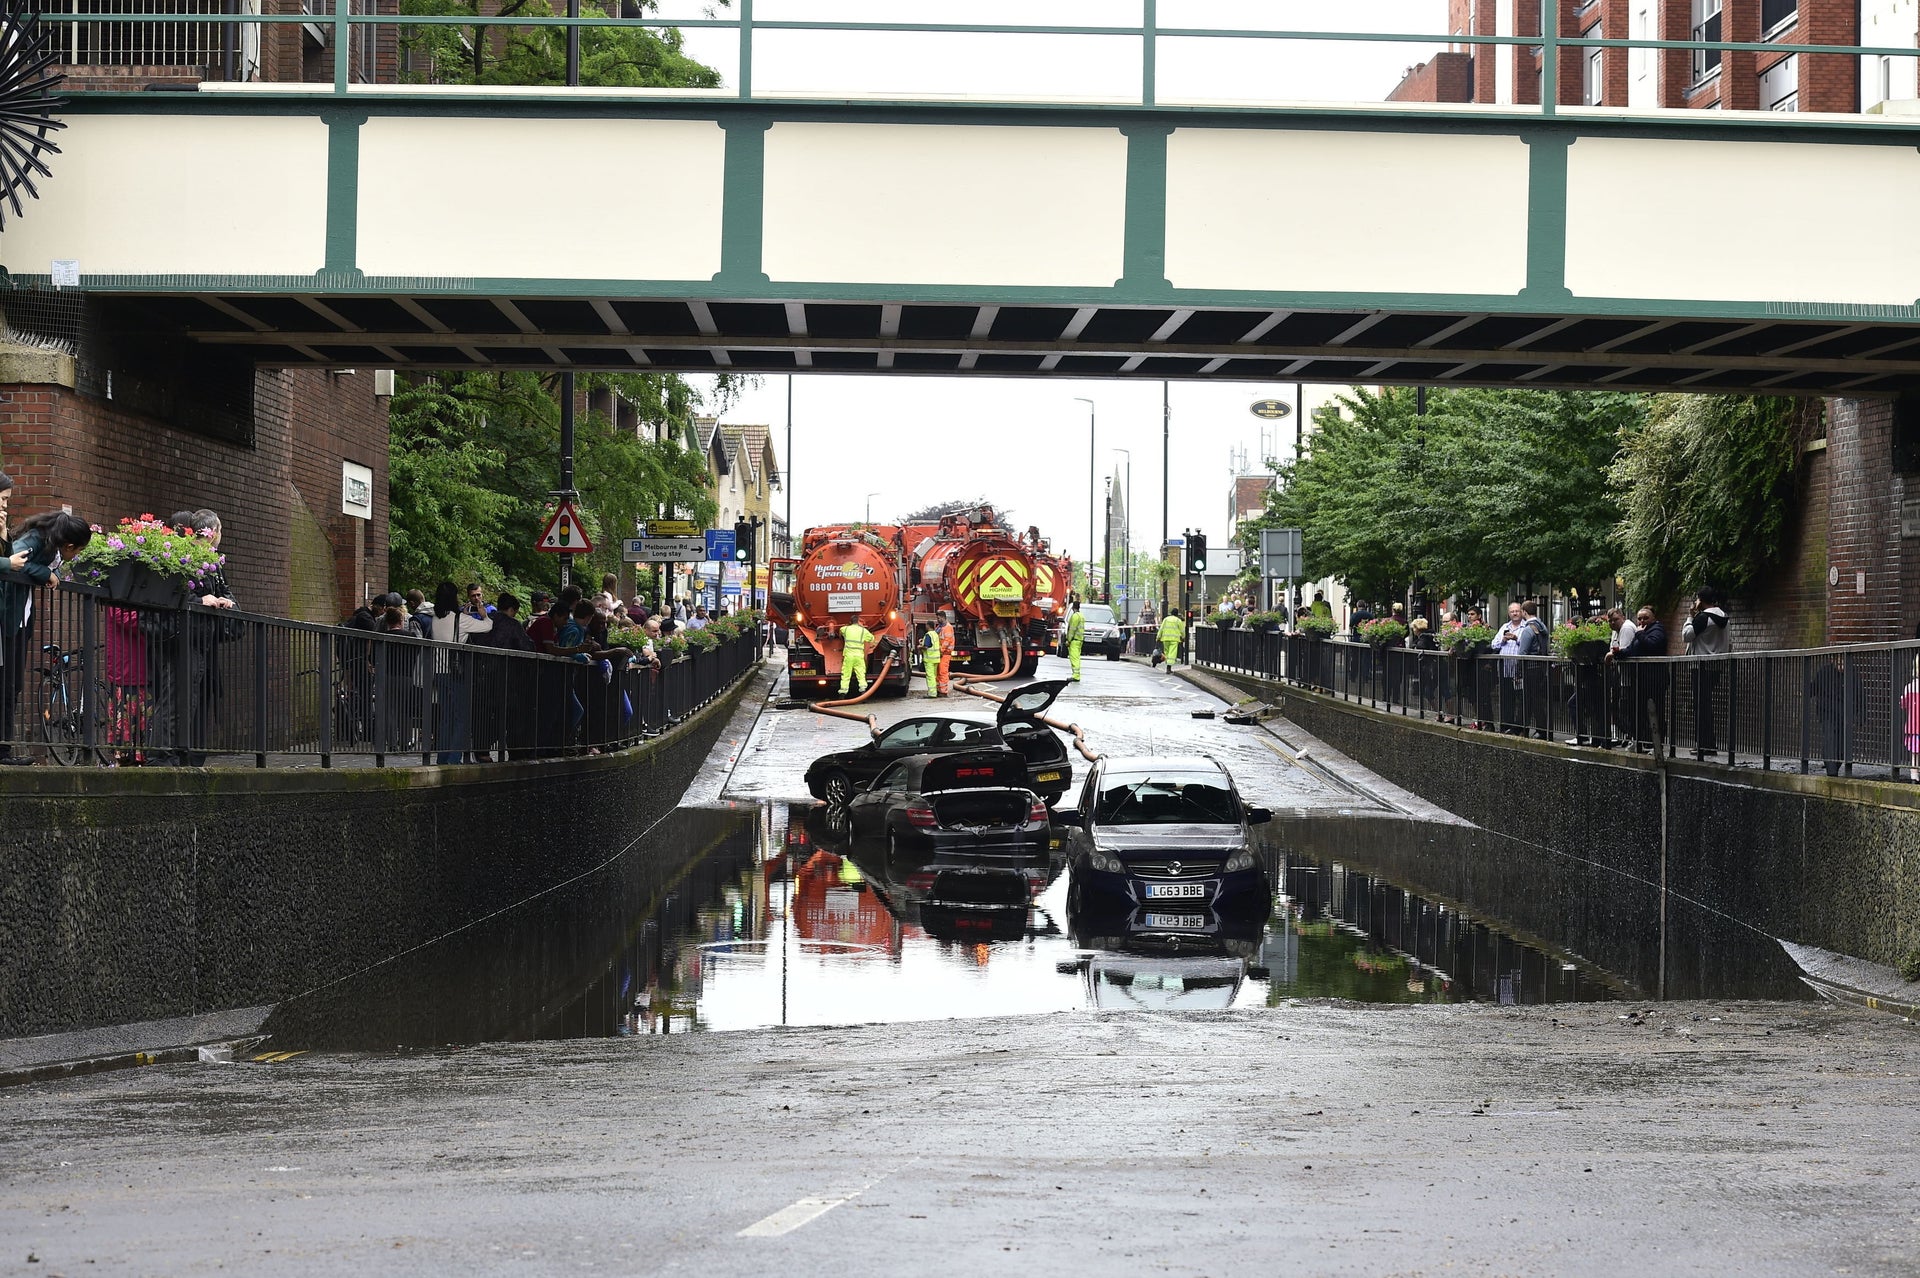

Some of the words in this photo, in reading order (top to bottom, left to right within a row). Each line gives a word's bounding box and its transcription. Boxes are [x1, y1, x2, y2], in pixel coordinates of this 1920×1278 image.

[814, 564, 843, 573] Hydro
[816, 570, 864, 579] Cleansing
[810, 583, 832, 592] 0800
[836, 583, 853, 591] 740
[857, 582, 880, 591] 8888
[1153, 886, 1180, 896] LG63
[1183, 885, 1203, 896] BBE
